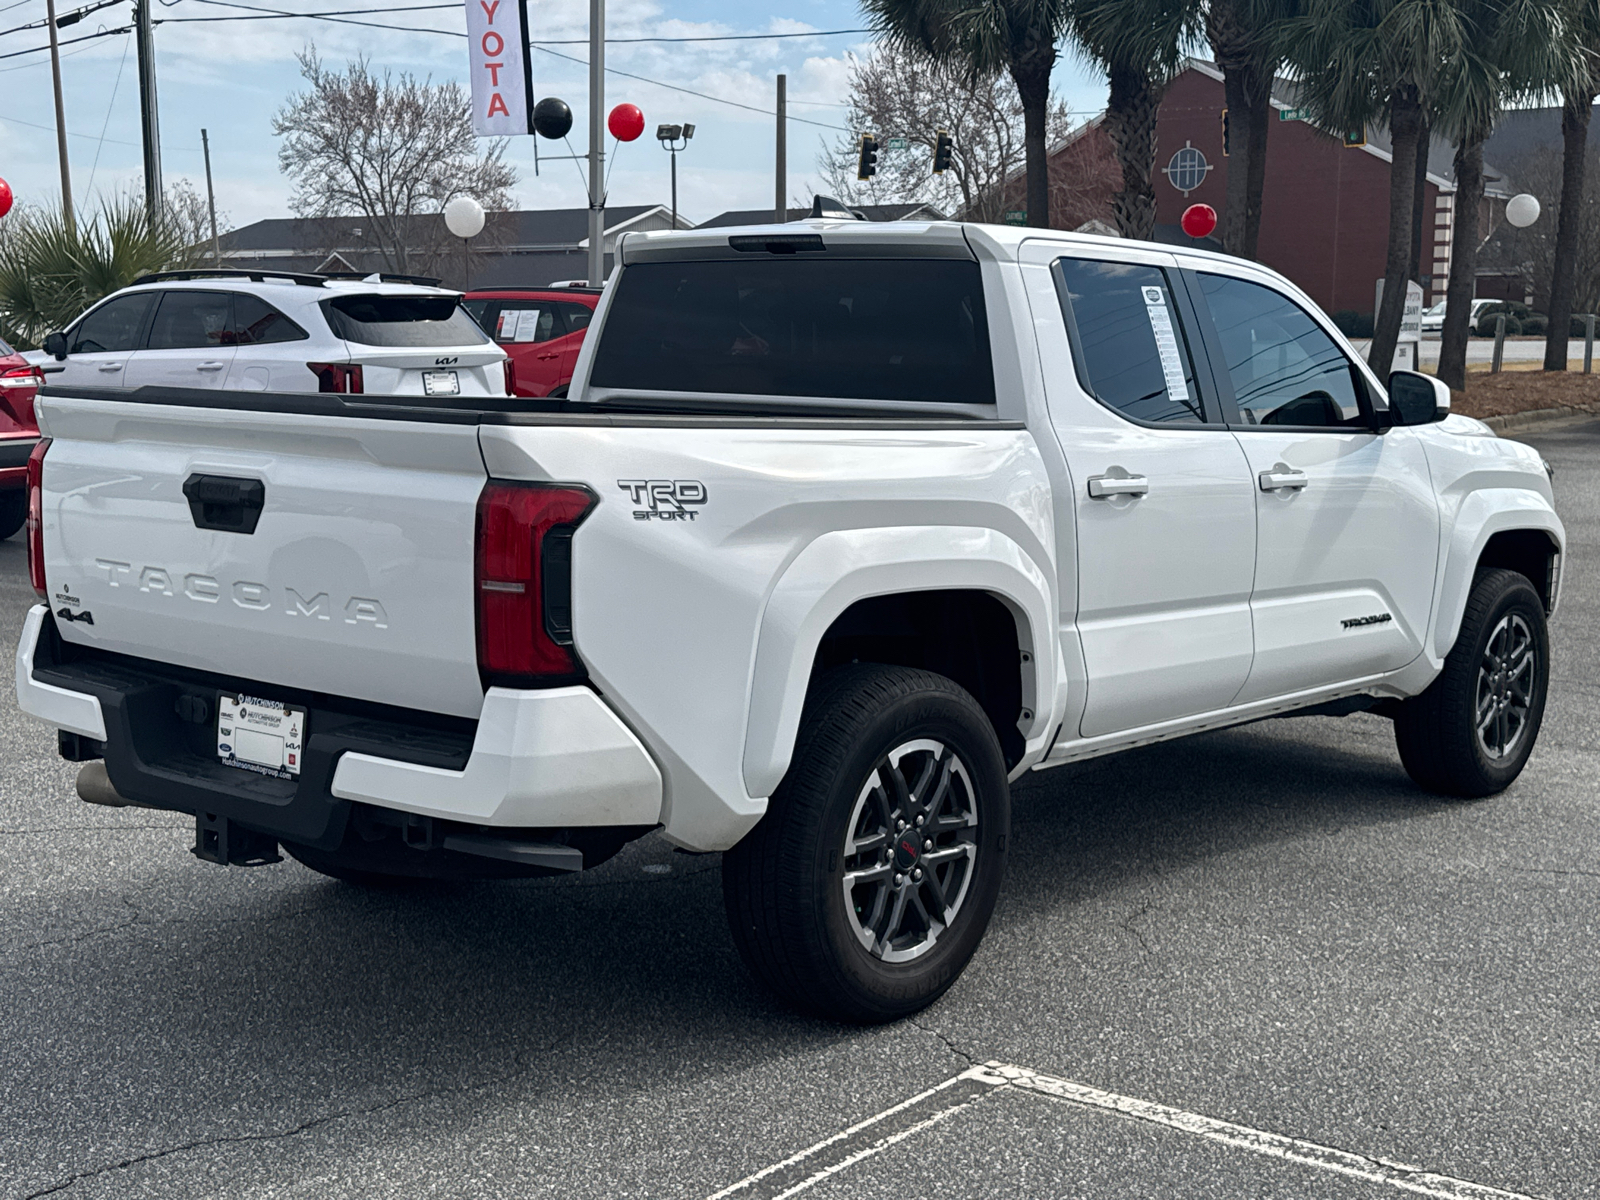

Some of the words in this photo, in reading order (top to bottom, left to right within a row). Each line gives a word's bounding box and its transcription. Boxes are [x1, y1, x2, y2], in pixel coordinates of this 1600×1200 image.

[1405, 291, 1420, 302] OYOTA
[1403, 305, 1419, 316] LBANY
[435, 357, 459, 365] KIA
[617, 479, 708, 511] TRD
[632, 510, 699, 521] SPORT
[56, 593, 80, 603] HUTCHINSON
[95, 557, 388, 629] TACOMA
[1340, 613, 1392, 629] TACOMA
[245, 696, 285, 710] HUTCHINSON
[247, 710, 282, 724] HUTCHINSON
[285, 742, 301, 751] KIA
